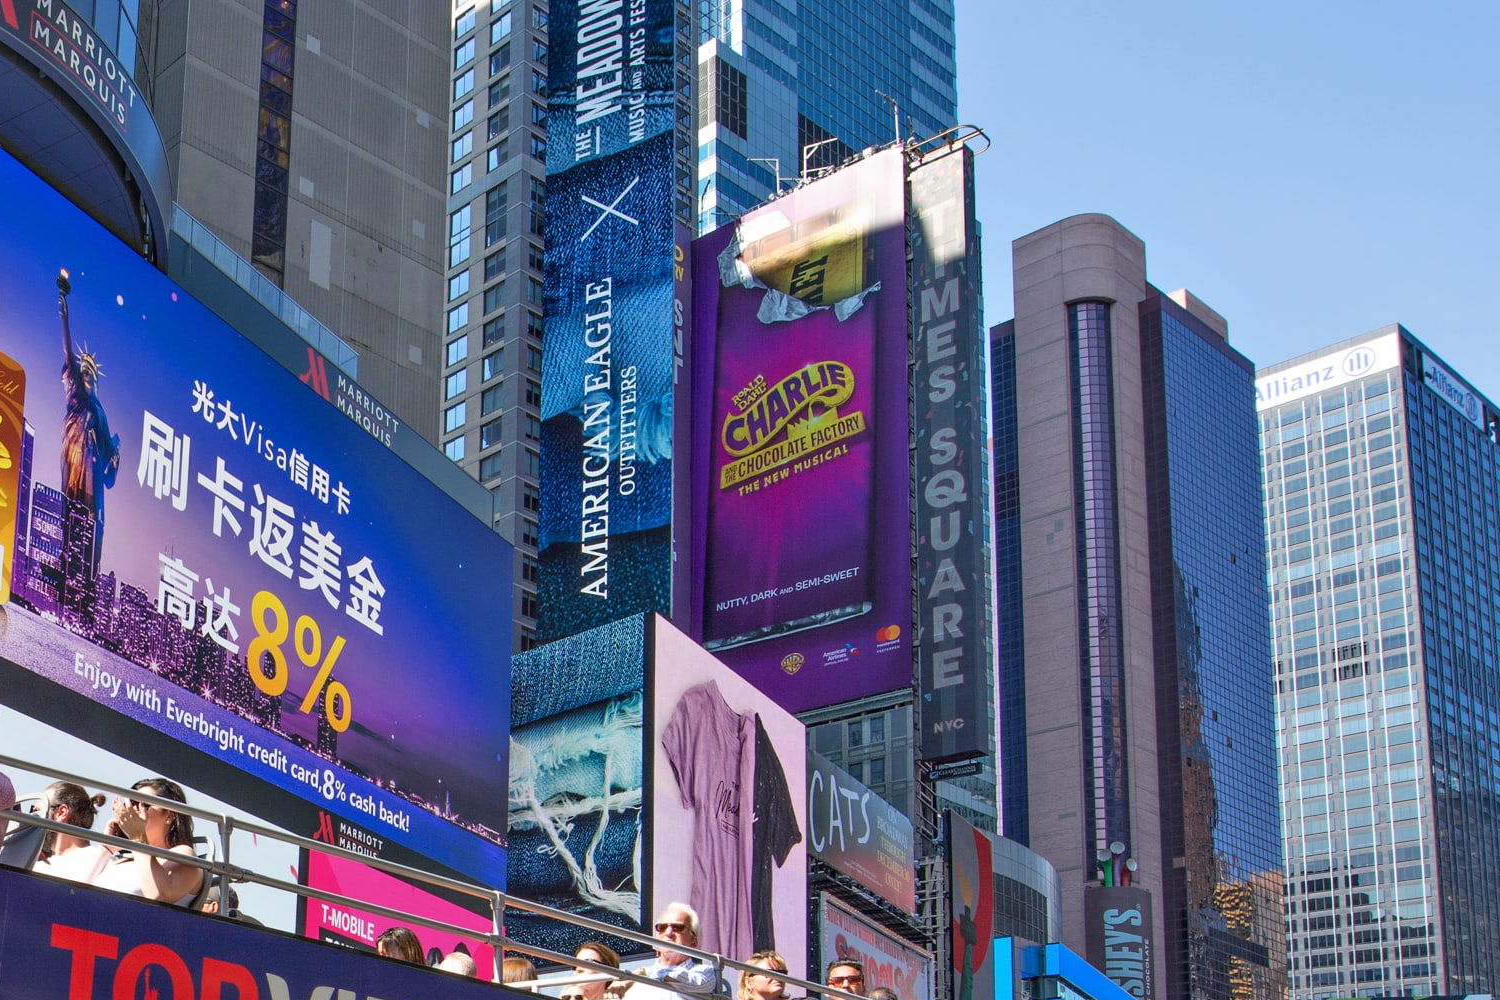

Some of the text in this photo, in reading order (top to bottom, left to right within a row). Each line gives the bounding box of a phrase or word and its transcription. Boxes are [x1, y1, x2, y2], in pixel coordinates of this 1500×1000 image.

[34, 20, 125, 124] MARQUIS
[36, 0, 136, 108] MARRIOTT
[629, 28, 645, 66] ARTS
[632, 66, 642, 90] AND
[576, 128, 591, 161] THE
[629, 93, 645, 144] MUSIC
[337, 374, 400, 434] MARRIOTT
[725, 364, 846, 451] CHARLIE
[731, 375, 765, 406] ROALD
[1255, 366, 1334, 403] Allianz
[1429, 365, 1465, 408] Allianz
[191, 379, 351, 516] 光大Visa信用卡
[336, 394, 393, 448] MARQUIS
[580, 276, 613, 600] AMERICAN EAGLE
[619, 365, 637, 497] OUTFITTERS
[738, 415, 860, 477] CHOCOLATE FACTORY
[738, 444, 849, 496] THE NEW MUSICAL
[137, 411, 387, 636] 刷卡返美金
[924, 427, 967, 689] SQUARE
[716, 567, 860, 612] NUTTY, DARK AND SEMI-SWEET
[823, 648, 847, 658] American
[74, 653, 122, 700] Enjoy
[126, 681, 161, 714] with
[166, 701, 244, 757] Everbright
[247, 739, 288, 774] credit
[349, 792, 376, 817] cash
[379, 801, 410, 833] back!
[934, 718, 965, 734] NYC
[339, 822, 384, 850] MARRIOTT
[809, 769, 870, 853] CATS
[321, 904, 375, 943] T-MOBILE
[1144, 939, 1152, 995] CHOCOLATE
